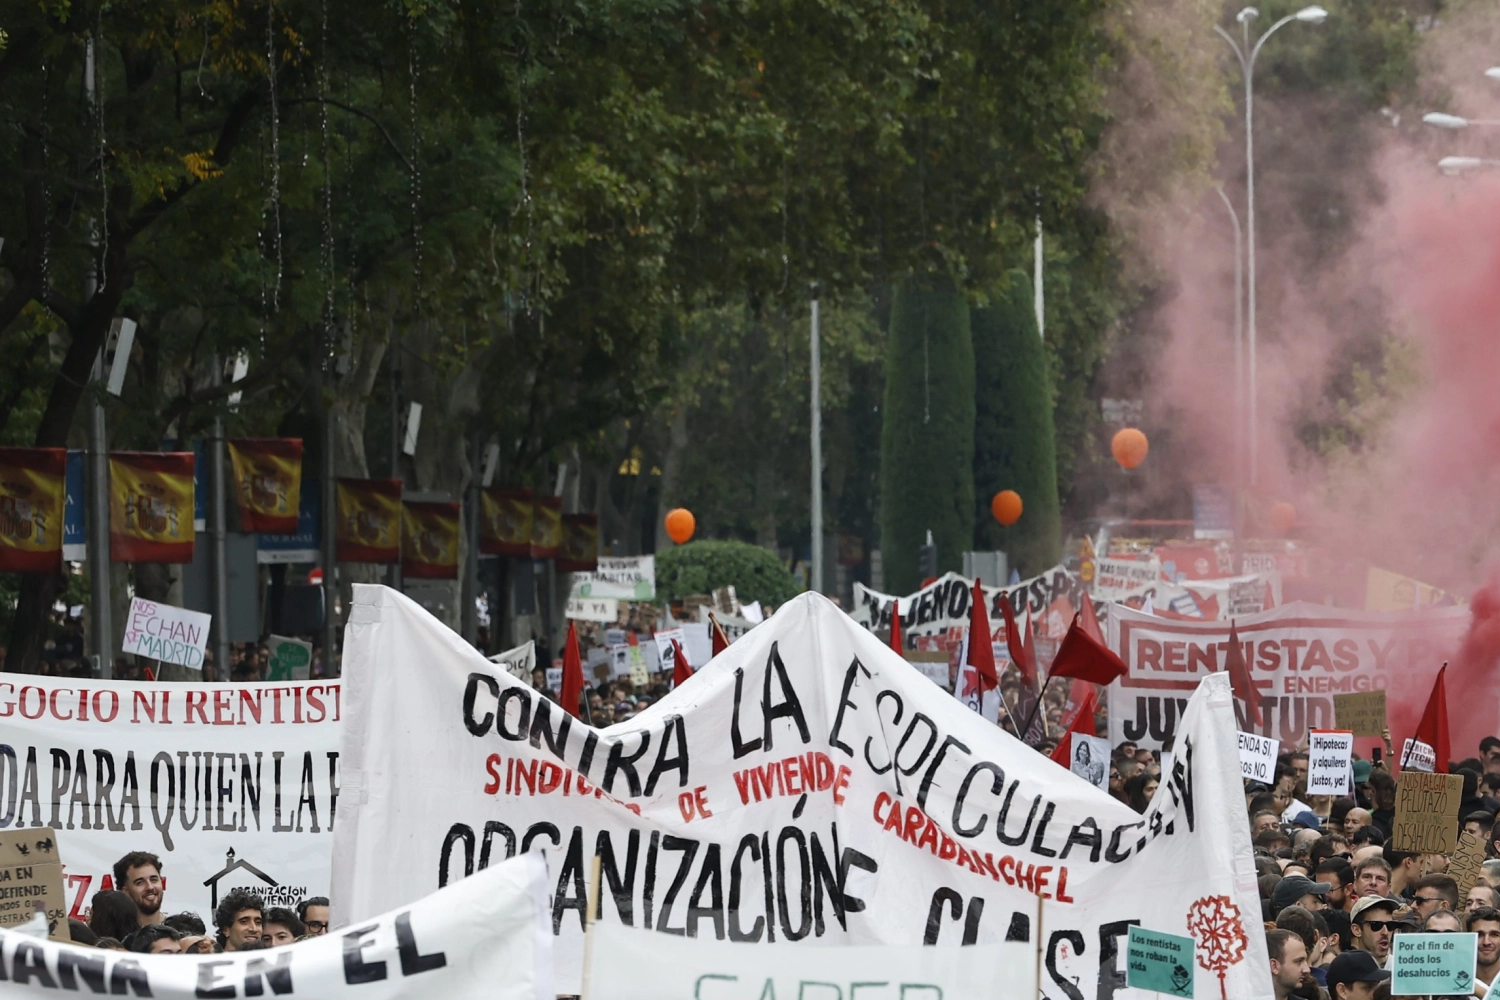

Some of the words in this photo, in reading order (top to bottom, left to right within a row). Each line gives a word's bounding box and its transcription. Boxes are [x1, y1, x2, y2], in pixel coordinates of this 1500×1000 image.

[132, 600, 156, 615] NOS
[132, 614, 201, 645] ECHAN
[137, 634, 203, 667] MADRID
[1137, 638, 1359, 673] RENTISTAS
[131, 690, 173, 724] NI
[731, 640, 812, 760] LA
[1318, 756, 1346, 770] alquileres
[1311, 774, 1333, 787] justos,
[1404, 773, 1446, 792] NOSTALGIA
[48, 748, 143, 831] PARA
[150, 751, 264, 851] QUIEN
[272, 751, 321, 832] LA
[678, 785, 713, 823] DE
[1400, 789, 1448, 814] PELOTAZO
[1397, 823, 1448, 854] DESAHUCIOS
[16, 867, 33, 880] EN
[1132, 933, 1145, 944] Los
[1146, 938, 1181, 952] rentistas
[1399, 942, 1414, 951] Por
[1417, 941, 1425, 950] el
[1428, 941, 1440, 950] fin
[1442, 941, 1454, 950] de
[195, 953, 293, 999] EN
[342, 911, 447, 985] EL
[1130, 948, 1144, 958] nos
[1146, 951, 1168, 963] roban
[1170, 955, 1177, 965] la
[1398, 955, 1425, 964] todos
[1427, 955, 1441, 964] los
[1130, 961, 1147, 972] vida
[1397, 969, 1451, 978] desahucios
